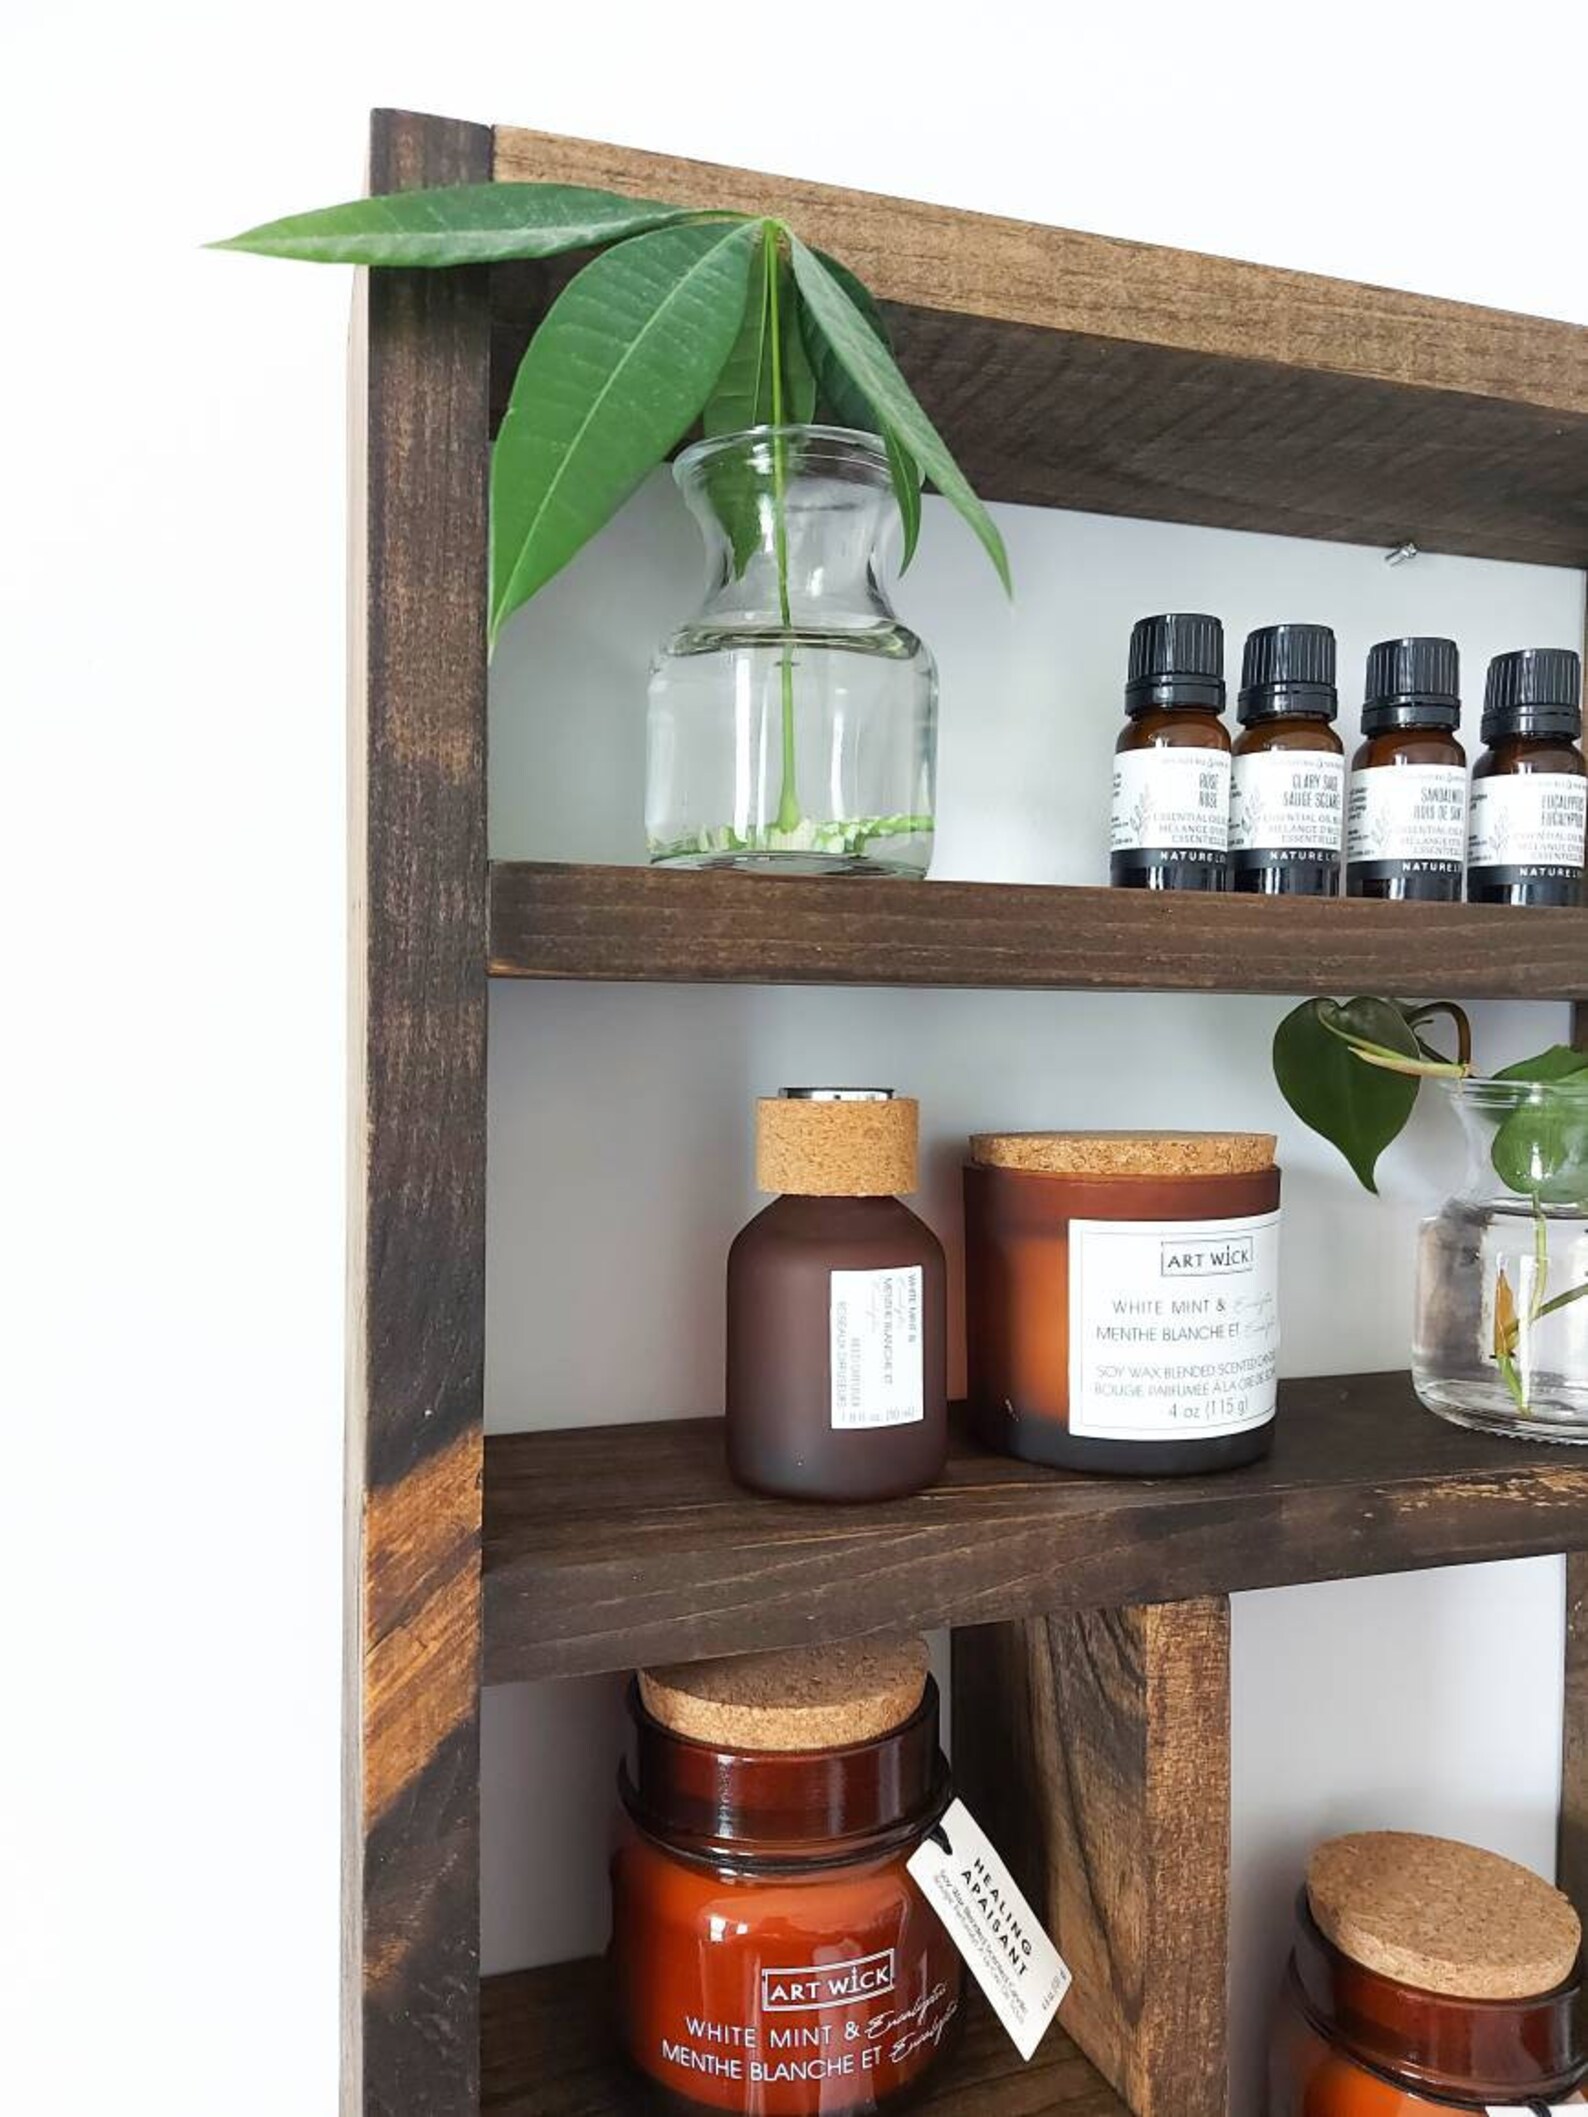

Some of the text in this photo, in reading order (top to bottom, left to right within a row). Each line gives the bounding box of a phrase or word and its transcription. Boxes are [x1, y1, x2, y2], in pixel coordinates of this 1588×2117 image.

[1167, 1255, 1204, 1268] ART
[1112, 1299, 1162, 1315] WHITE
[1171, 1299, 1209, 1314] MINT
[1215, 1297, 1226, 1312] &
[1096, 1325, 1157, 1341] MENTHE
[1162, 1325, 1224, 1341] BLANCHE
[1228, 1322, 1240, 1338] ET
[1097, 1365, 1125, 1379] SOY
[1127, 1365, 1162, 1380] WAX
[1164, 1364, 1216, 1380] BLENDED
[1094, 1383, 1144, 1398] BOUGIE
[1168, 1402, 1177, 1419] 4
[1183, 1406, 1201, 1419] oz
[1205, 1396, 1234, 1420] (115
[973, 1857, 1032, 1957] HEALING
[961, 1869, 1029, 1977] APAISANT
[770, 1982, 820, 2001] ART
[685, 2015, 757, 2049] WHITE
[769, 2025, 833, 2049] MINT
[843, 2020, 861, 2042] &
[661, 2038, 742, 2081] MENTHE
[750, 2053, 854, 2082] BLANCHE
[861, 2045, 882, 2070] ET
